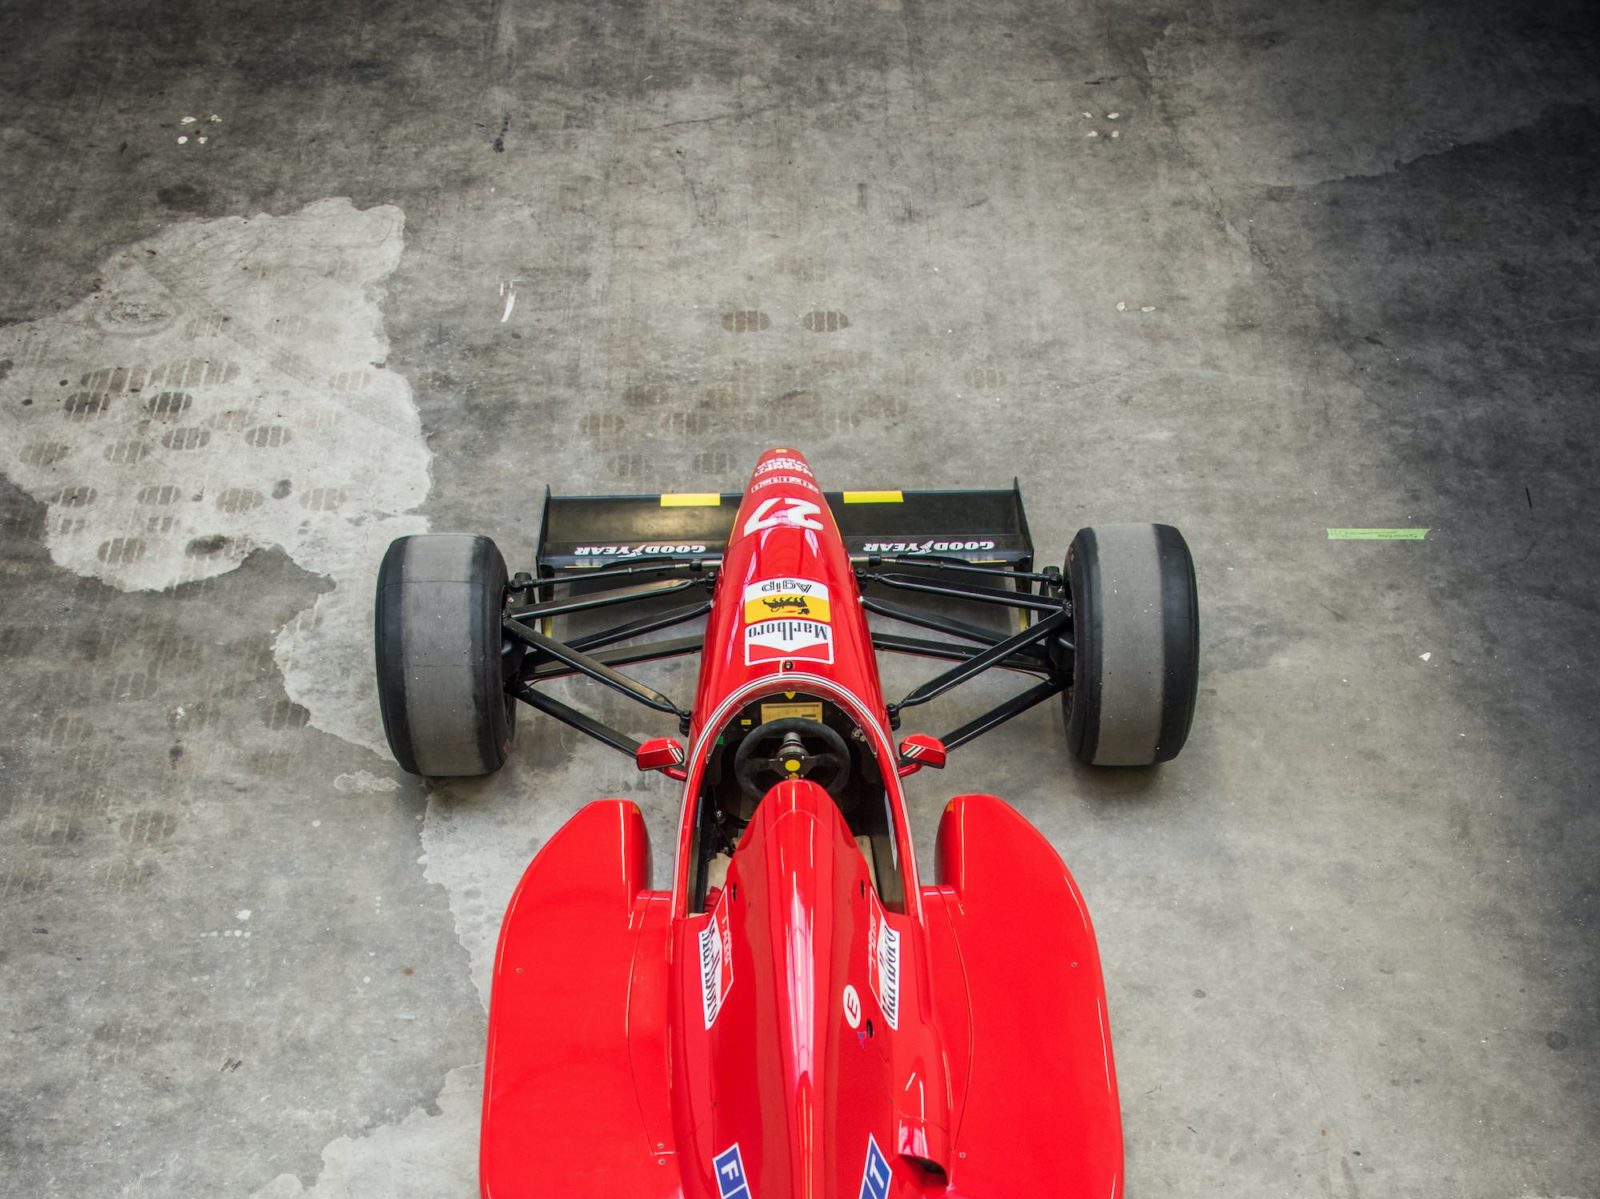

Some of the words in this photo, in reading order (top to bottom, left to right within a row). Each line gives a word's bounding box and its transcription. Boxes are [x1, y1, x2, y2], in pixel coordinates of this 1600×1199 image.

[744, 497, 824, 537] 27
[574, 543, 707, 559] GOODYEAR
[863, 540, 995, 556] GOODYEAR
[761, 579, 813, 594] Agip
[748, 622, 828, 642] Marlboro
[701, 919, 720, 1022] Marlboro
[880, 924, 898, 1027] Marlboro
[846, 993, 859, 1019] E
